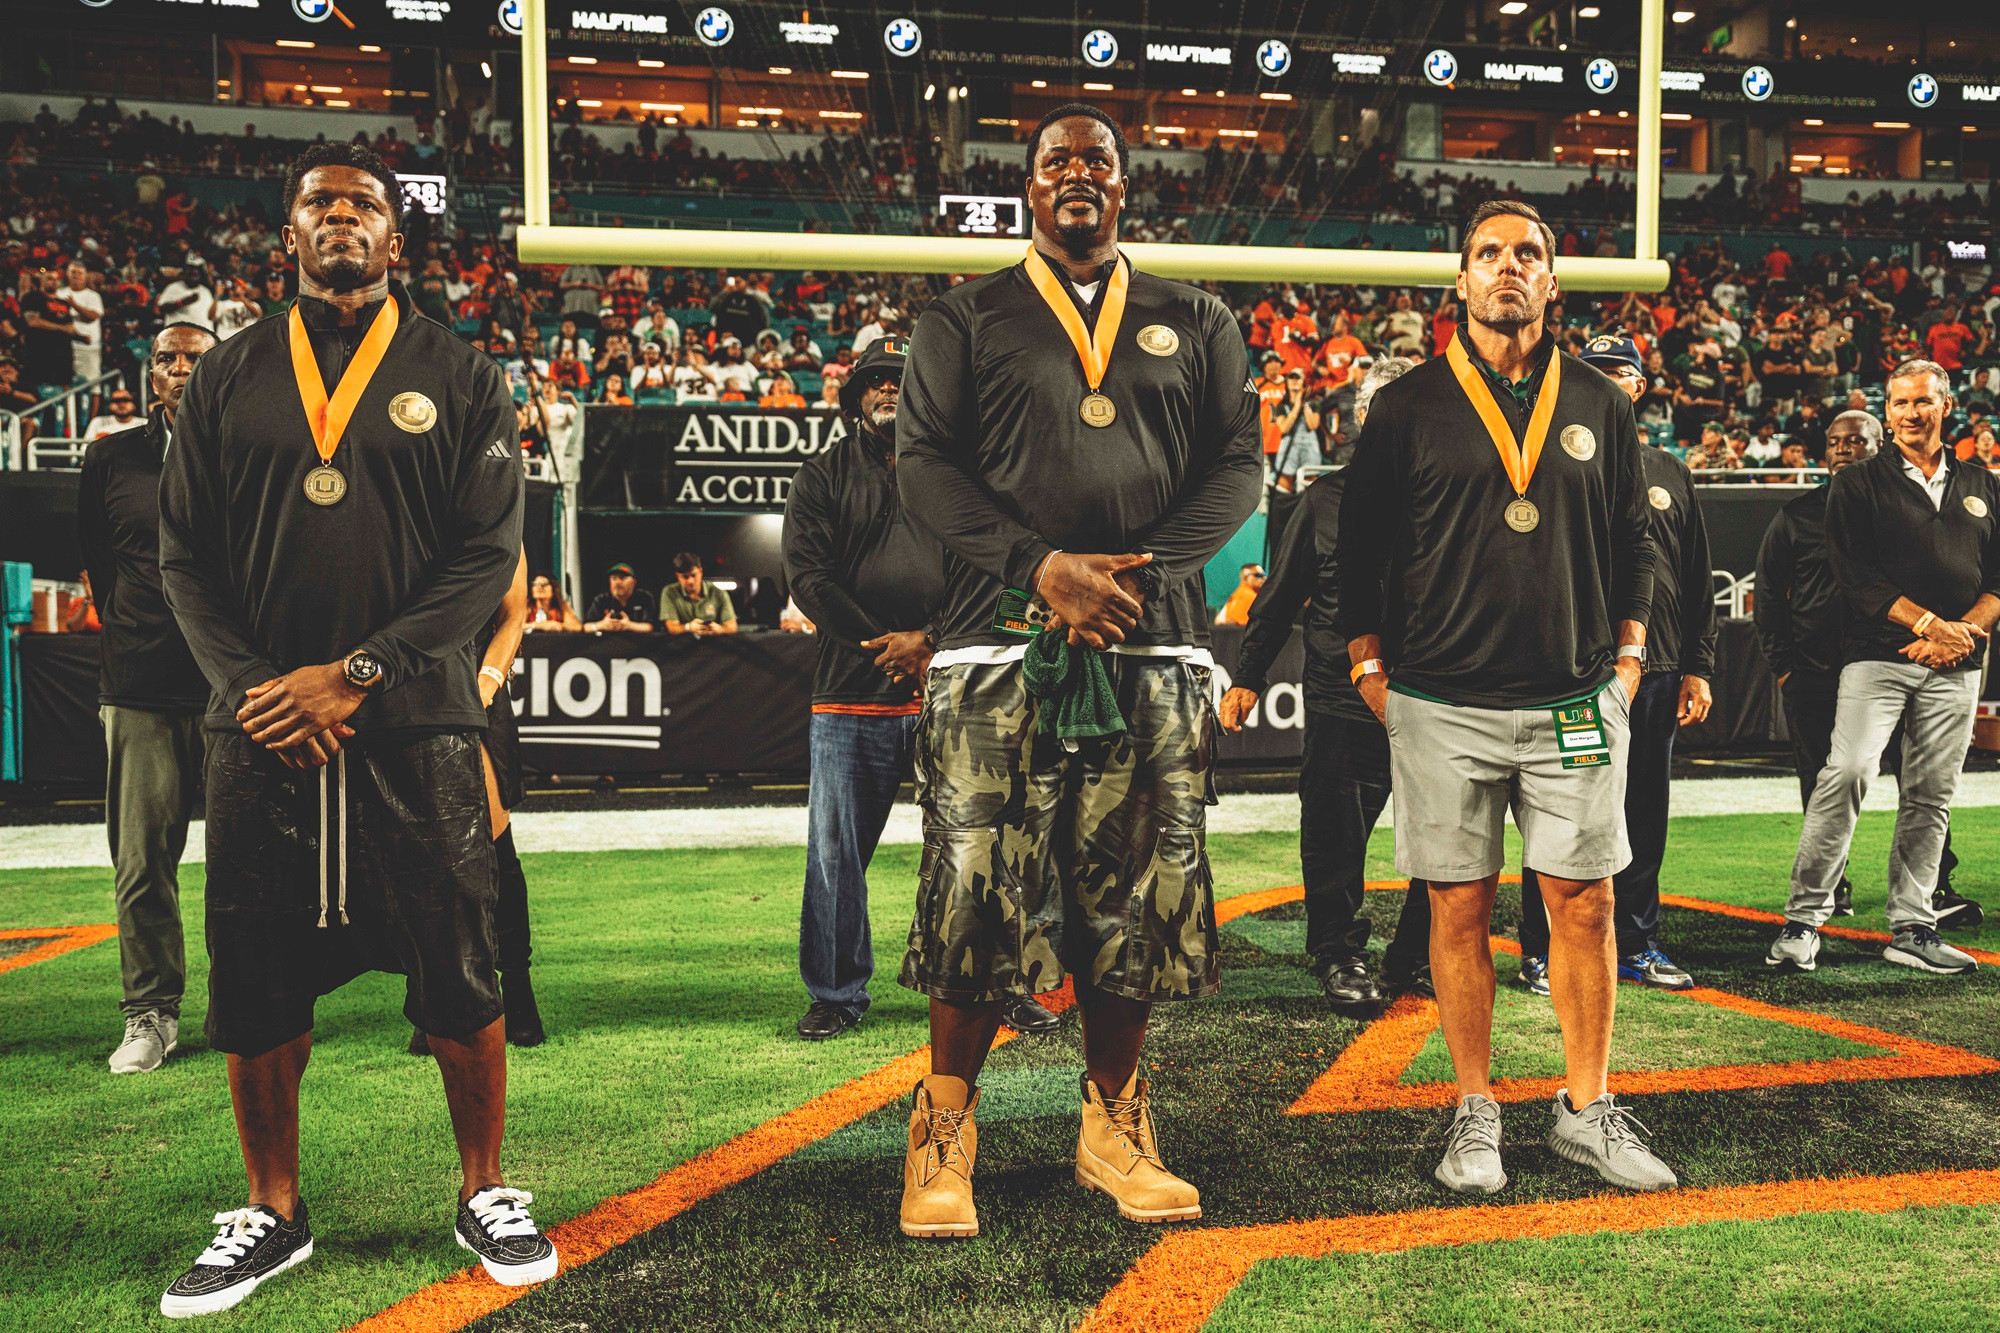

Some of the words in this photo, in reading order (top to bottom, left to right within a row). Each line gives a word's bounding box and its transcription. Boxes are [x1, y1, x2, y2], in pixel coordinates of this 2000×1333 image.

[572, 10, 667, 33] HALFTIME
[1146, 44, 1231, 65] HALFTIME
[1484, 63, 1563, 82] HALFTIME
[965, 202, 997, 226] 25
[685, 377, 707, 395] 32
[673, 413, 860, 454] ANIDJA
[1005, 620, 1030, 631] FIELD
[1573, 755, 1598, 764] FIELD
